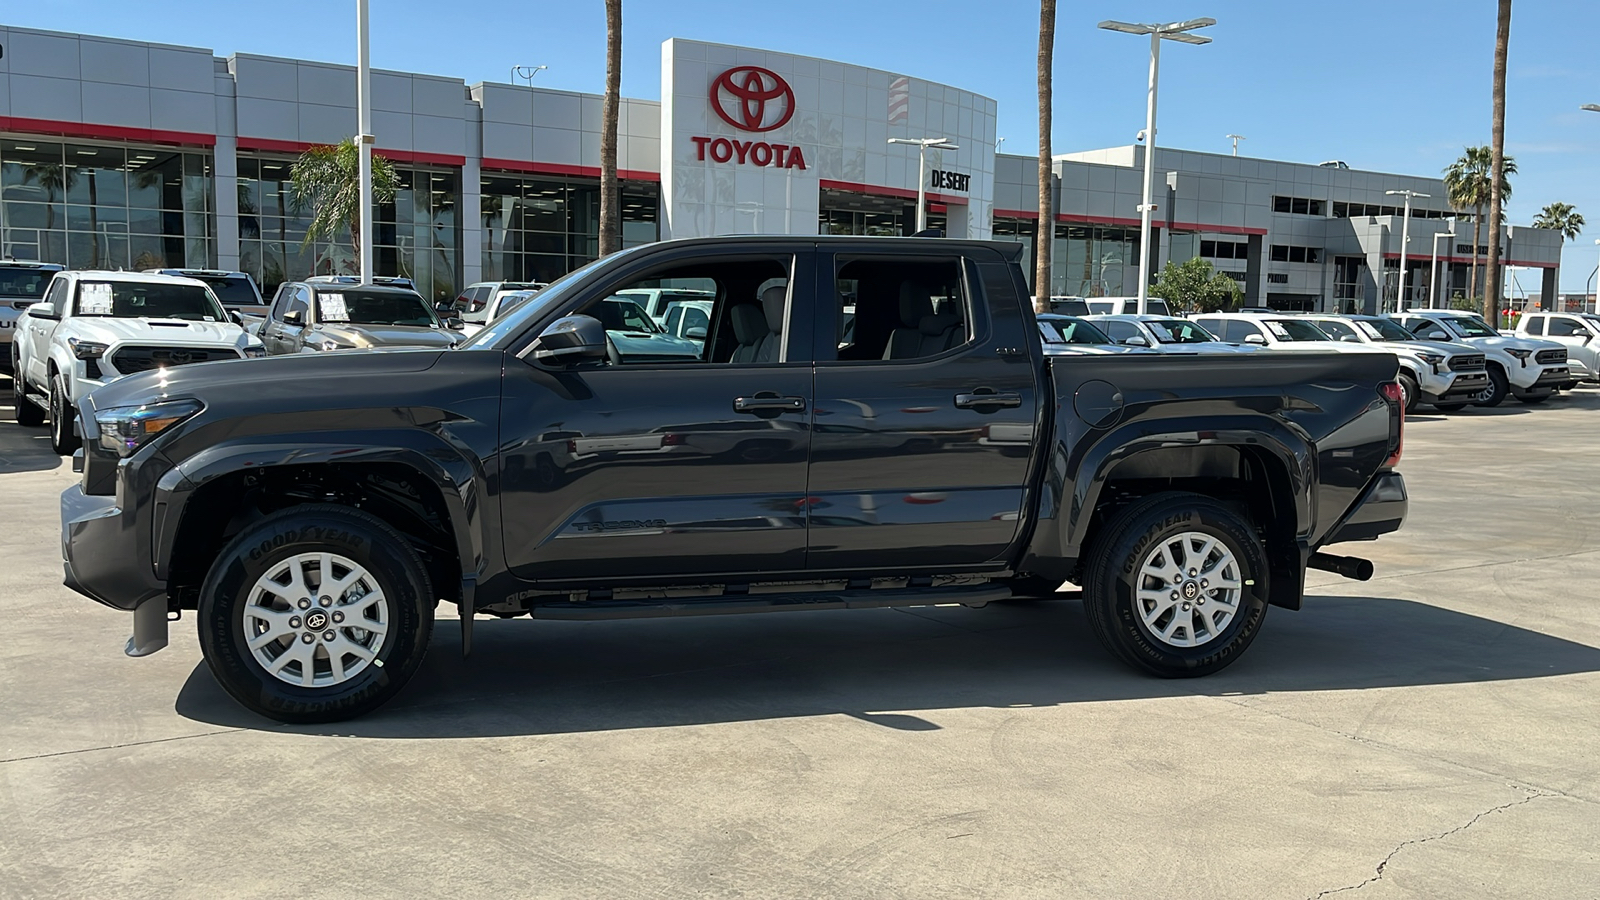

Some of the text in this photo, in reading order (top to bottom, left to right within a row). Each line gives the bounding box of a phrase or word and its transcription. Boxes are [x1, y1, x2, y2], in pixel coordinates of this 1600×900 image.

[691, 136, 807, 170] TOYOTA
[931, 169, 971, 192] DESERT
[571, 518, 668, 531] TACOMA
